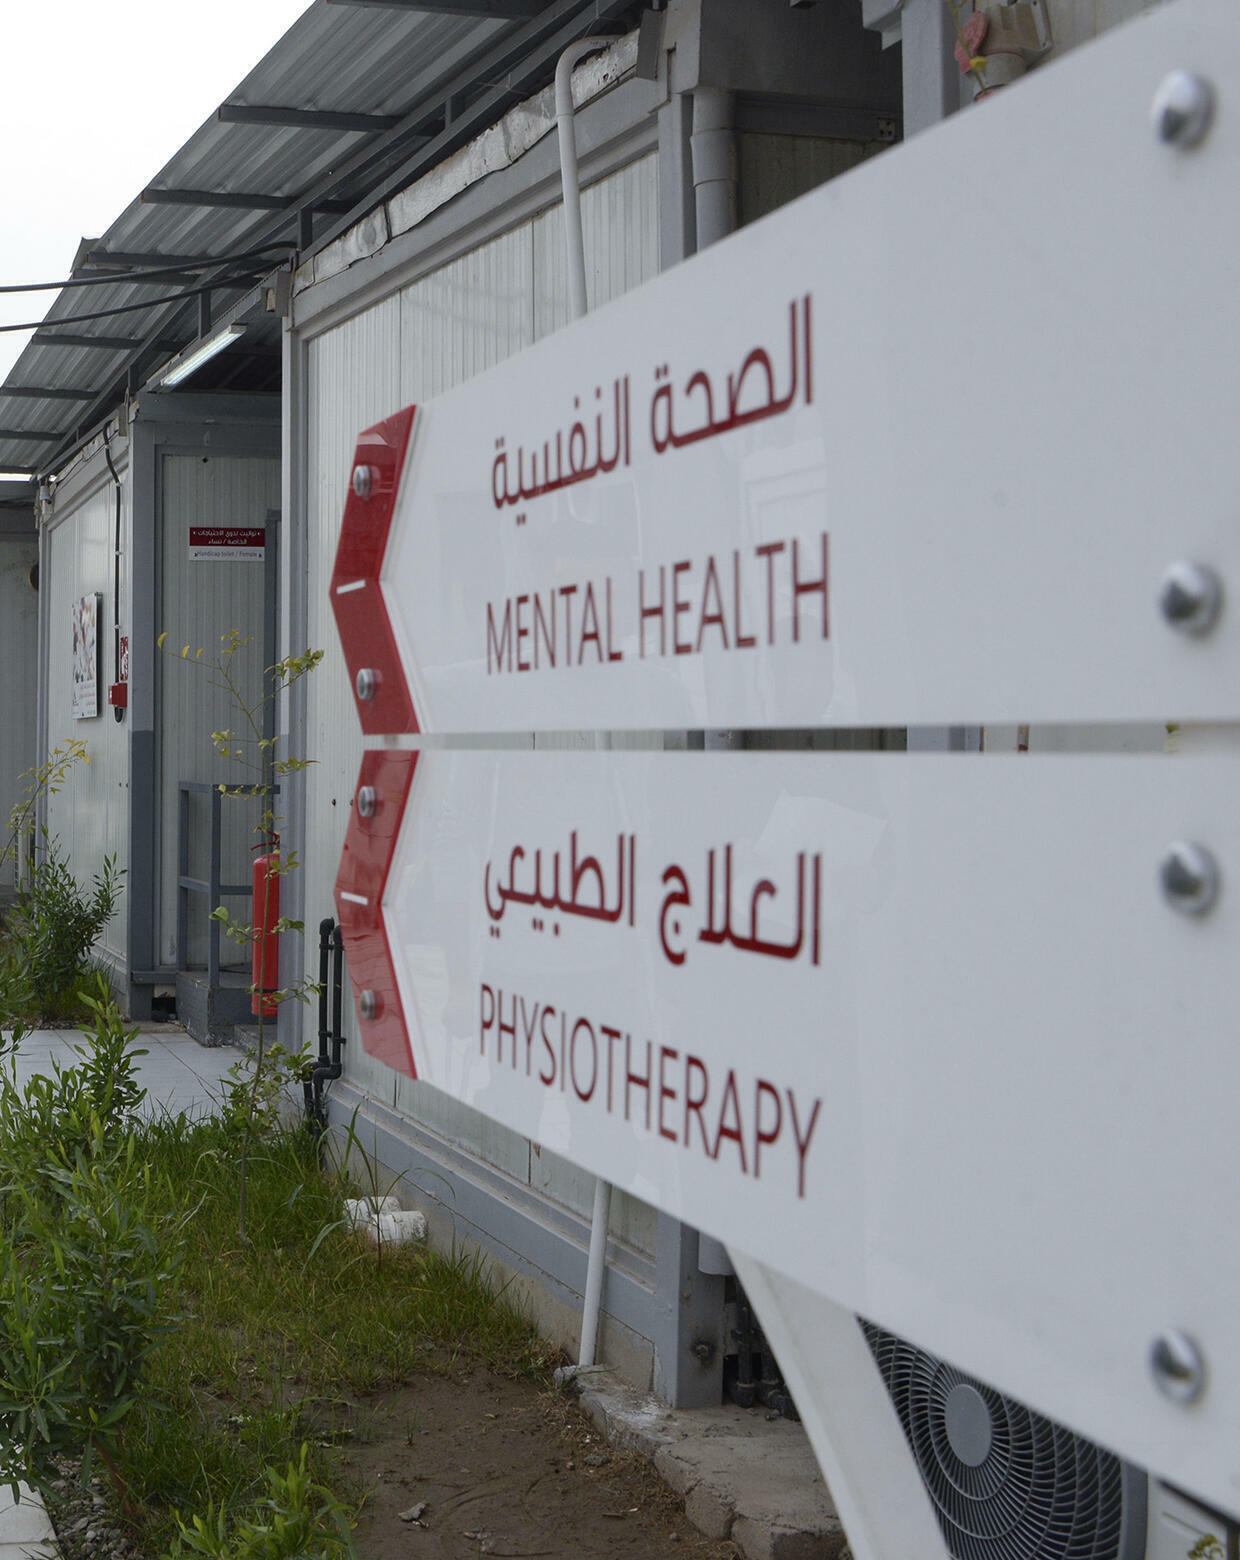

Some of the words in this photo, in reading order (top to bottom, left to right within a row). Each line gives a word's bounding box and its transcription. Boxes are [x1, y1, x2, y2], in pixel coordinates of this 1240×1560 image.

[650, 291, 813, 454] الصحة
[491, 373, 631, 527] النفسية
[486, 576, 623, 675] MENTAL
[638, 530, 829, 660] HEALTH
[483, 830, 636, 939] الطبيعي
[659, 842, 821, 967] العلاج
[479, 982, 823, 1201] PHYSIOTHERAPY
